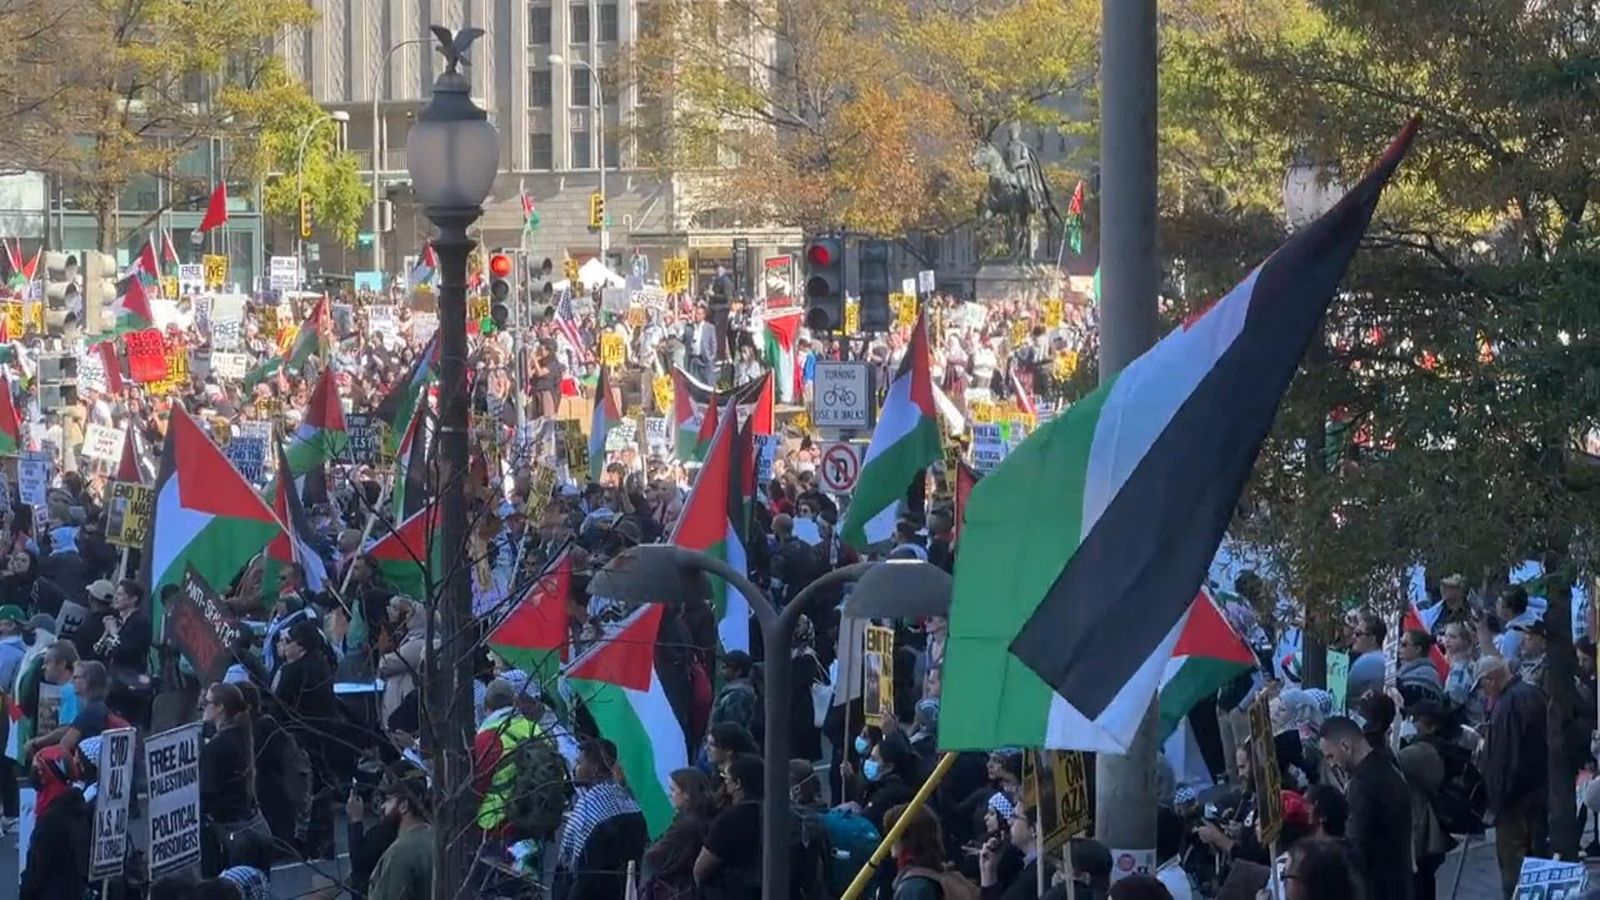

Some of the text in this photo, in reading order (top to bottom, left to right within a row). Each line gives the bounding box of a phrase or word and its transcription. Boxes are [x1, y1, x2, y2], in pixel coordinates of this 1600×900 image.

[665, 268, 687, 285] LIVE
[213, 322, 239, 337] FREE
[824, 369, 856, 380] TURNING
[646, 421, 664, 432] REE
[115, 484, 134, 499] END
[125, 528, 146, 542] GAZ
[110, 736, 128, 767] END
[150, 738, 197, 777] FREE ALL
[150, 766, 197, 799] PALESTINIAN
[152, 803, 198, 841] POLITICAL
[152, 828, 198, 864] PRISONERS
